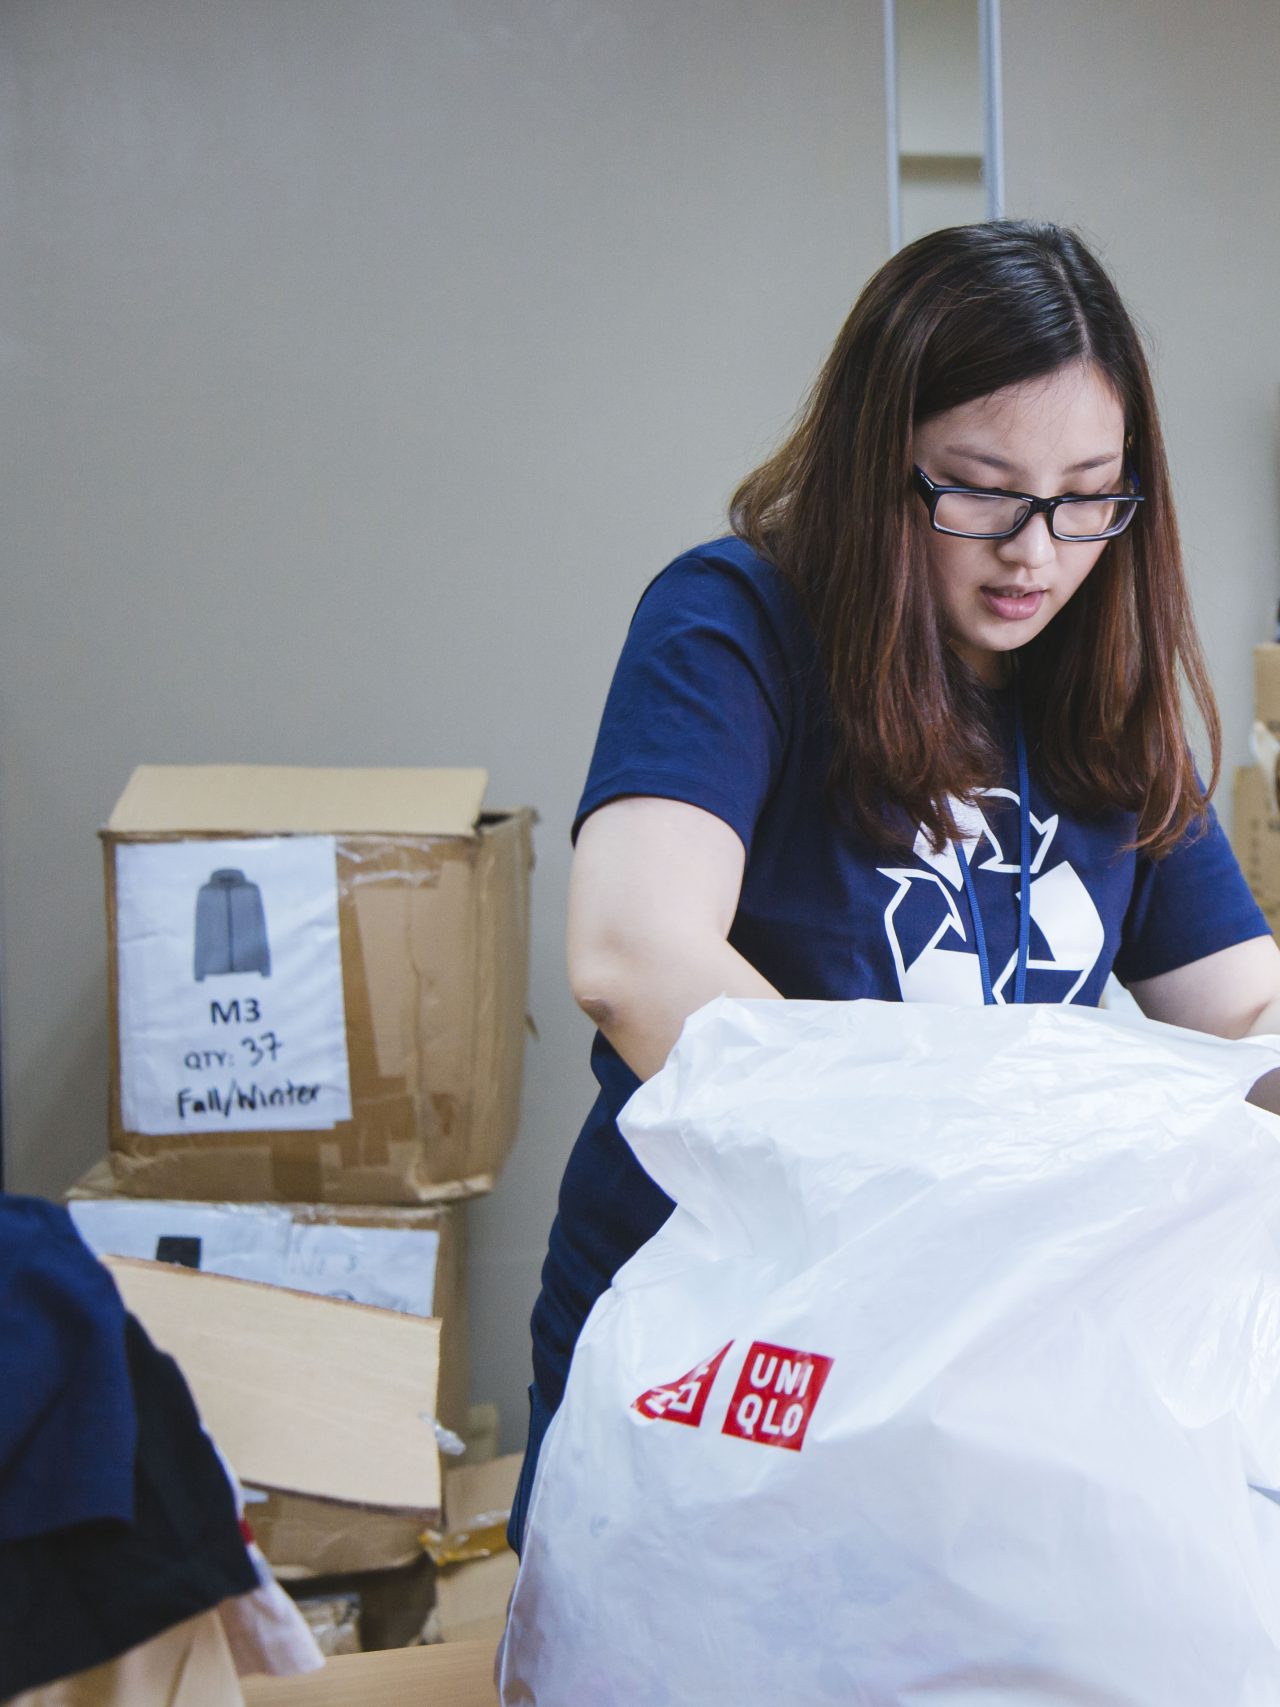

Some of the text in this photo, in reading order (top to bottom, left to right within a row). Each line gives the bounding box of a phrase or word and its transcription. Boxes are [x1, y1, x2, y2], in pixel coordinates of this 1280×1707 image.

[210, 998, 261, 1025] M3
[241, 1031, 283, 1067] 37
[177, 1079, 321, 1119] Fall/Winter
[750, 1353, 814, 1398] UNI
[736, 1393, 803, 1437] QLO
